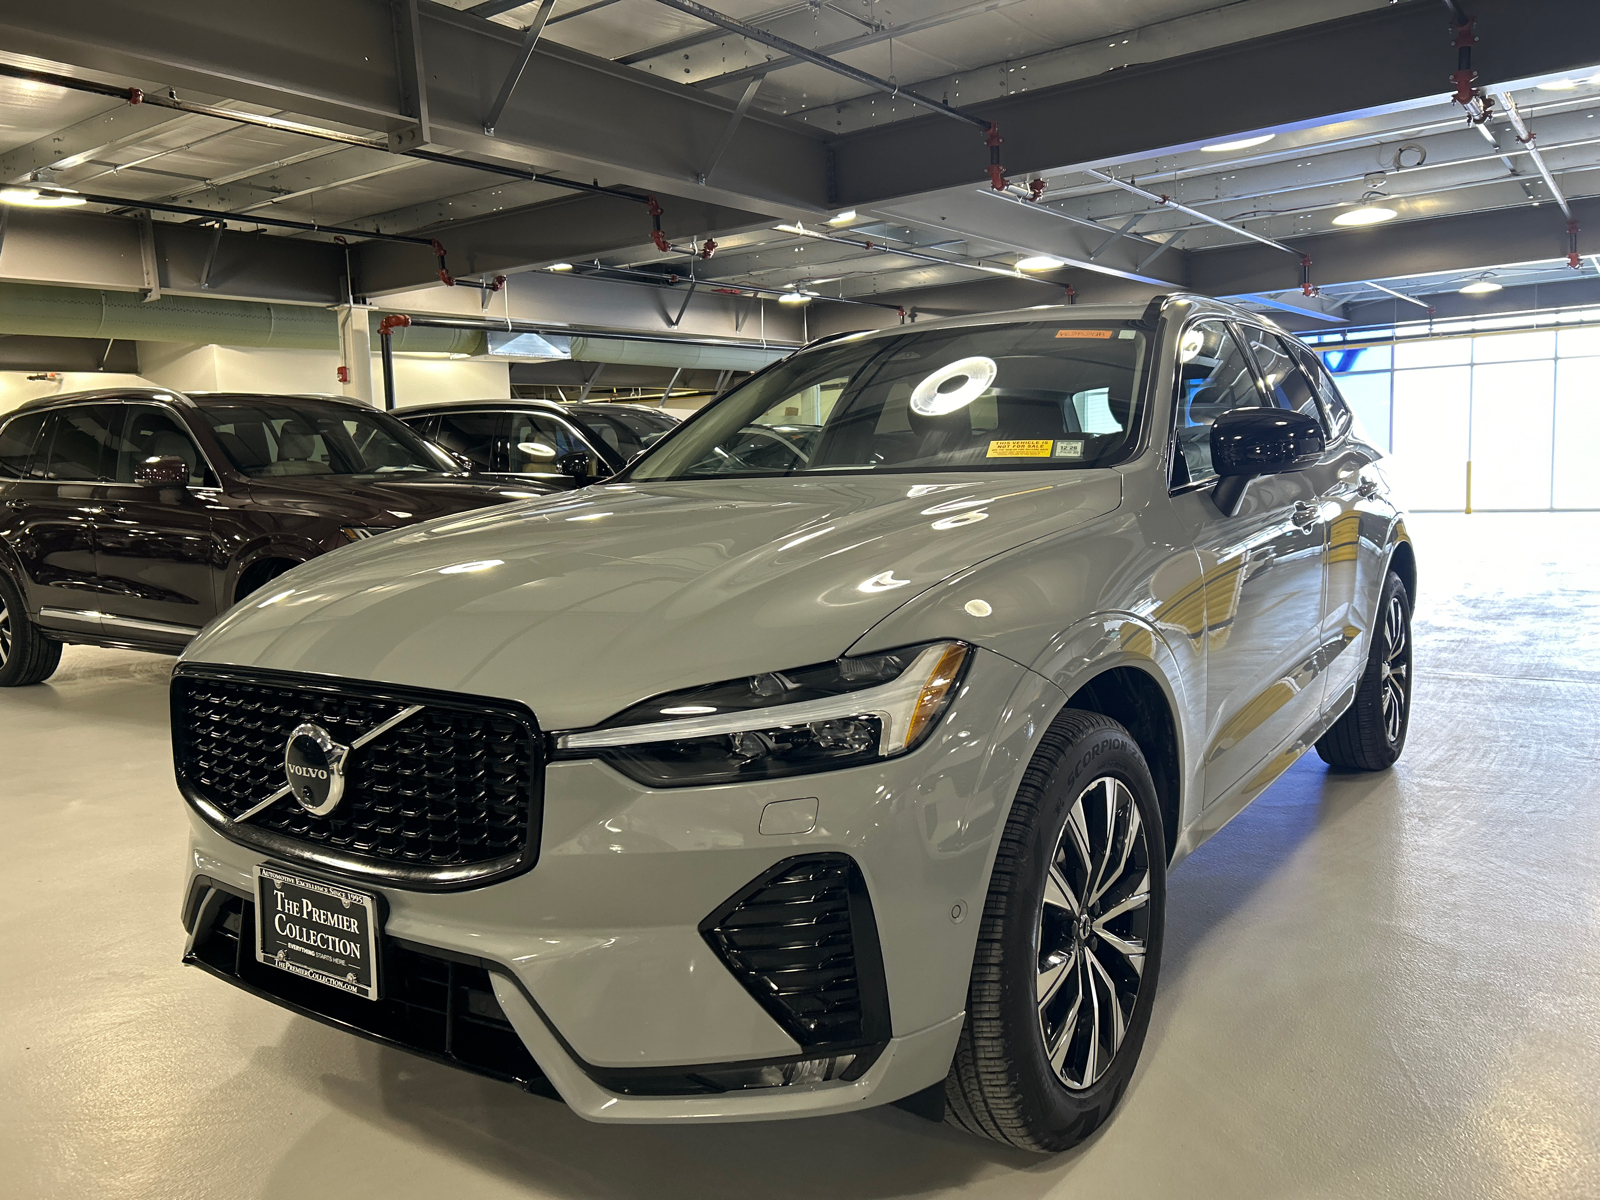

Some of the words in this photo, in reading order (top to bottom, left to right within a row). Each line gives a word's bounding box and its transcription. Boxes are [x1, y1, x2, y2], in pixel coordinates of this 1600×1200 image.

[287, 763, 328, 780] VOLVO
[1067, 738, 1128, 793] SCORPION
[347, 893, 364, 904] 1995
[287, 942, 316, 957] EVERYTHING
[315, 951, 333, 962] STARTS
